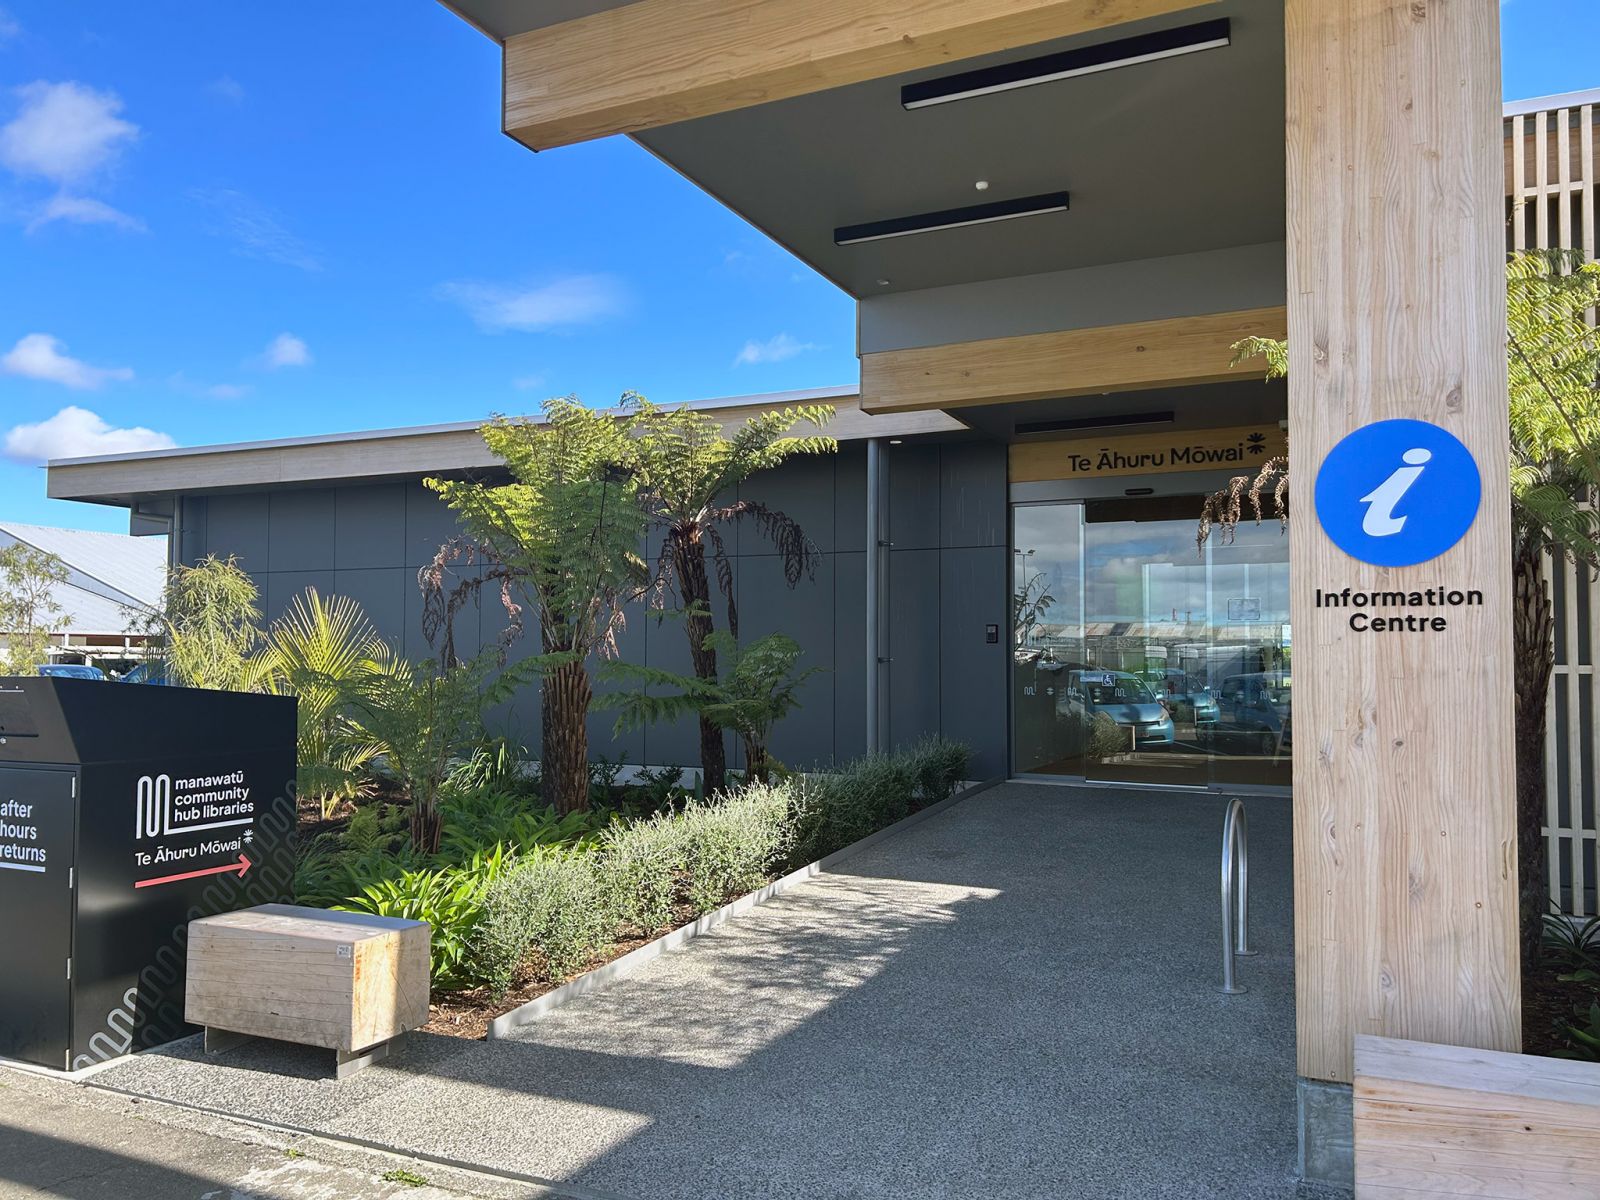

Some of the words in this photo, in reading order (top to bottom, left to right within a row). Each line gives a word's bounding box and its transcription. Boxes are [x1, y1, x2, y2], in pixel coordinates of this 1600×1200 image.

[1068, 455, 1091, 472] Te
[1096, 449, 1164, 471] Āhuru
[1170, 443, 1243, 465] Mōwai
[1316, 586, 1483, 608] Information
[1349, 612, 1447, 633] Centre
[175, 770, 244, 790] manawatū
[174, 787, 250, 806] community
[0, 799, 33, 818] after
[174, 807, 201, 822] hub
[202, 801, 254, 819] libraries
[0, 819, 37, 840] hours
[0, 843, 46, 862] returns
[135, 852, 152, 866] Te
[154, 845, 197, 863] Āhuru
[200, 837, 242, 856] Mōwai
